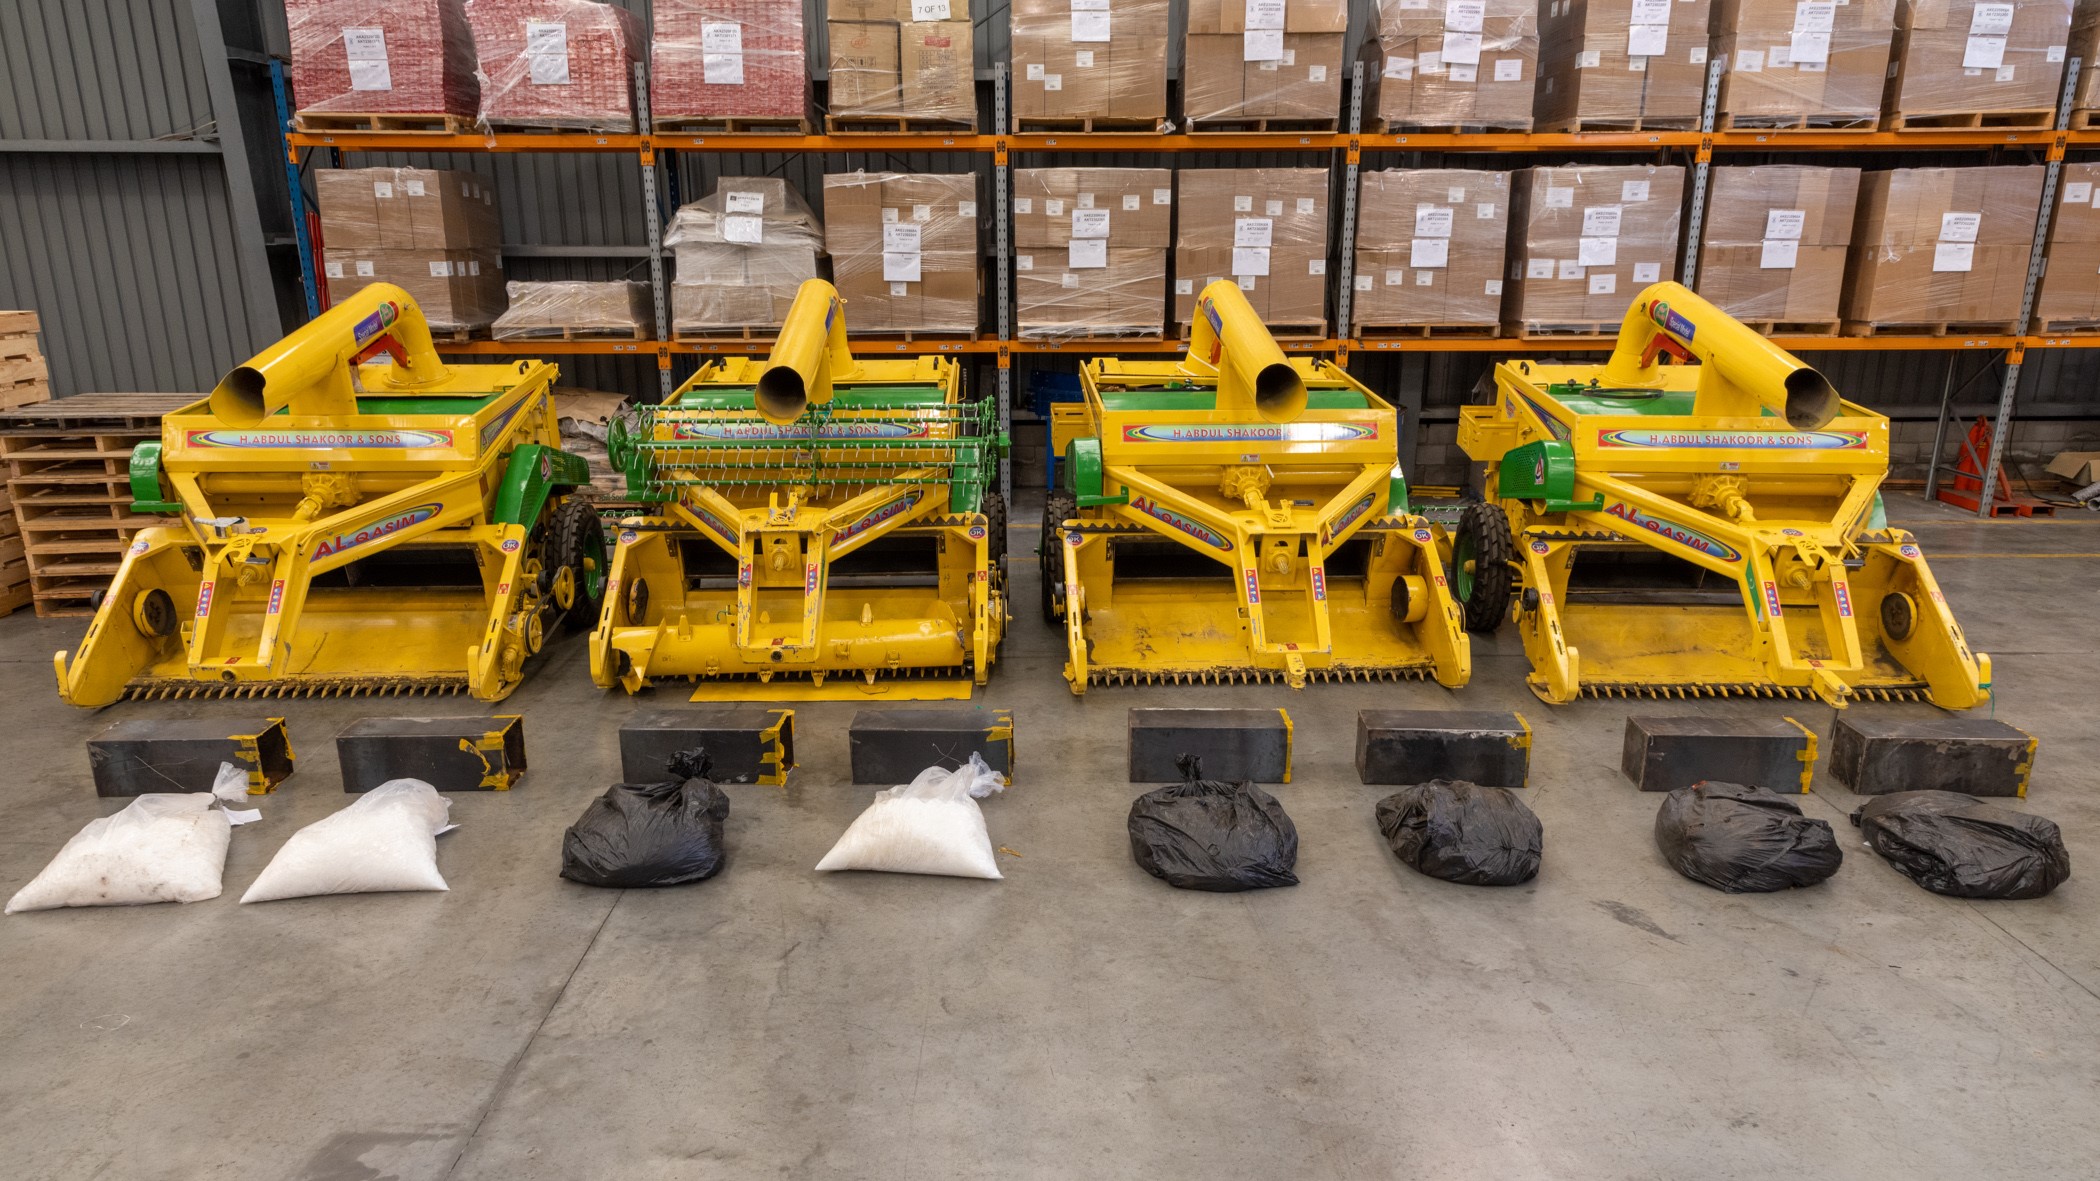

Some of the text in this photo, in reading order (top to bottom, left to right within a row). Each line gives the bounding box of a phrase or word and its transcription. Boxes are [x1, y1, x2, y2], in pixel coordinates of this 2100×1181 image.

[778, 425, 833, 435] SHAKOR
[837, 425, 844, 434] &
[849, 425, 879, 434] SONS
[1173, 428, 1223, 438] H.ABDUL
[1227, 427, 1282, 438] SHAKOOR
[240, 435, 401, 444] H.ABDUL SHAKOOR & SONS
[1650, 435, 1813, 445] H.ABDUL SHAKOOR & SONS
[832, 500, 905, 542] AL-QASIM
[1134, 496, 1211, 542] AL-QASIM
[1608, 502, 1710, 551] AL-QASIM
[314, 514, 416, 560] AL-QASIM
[502, 543, 517, 551] OK
[1902, 548, 1915, 556] OK
